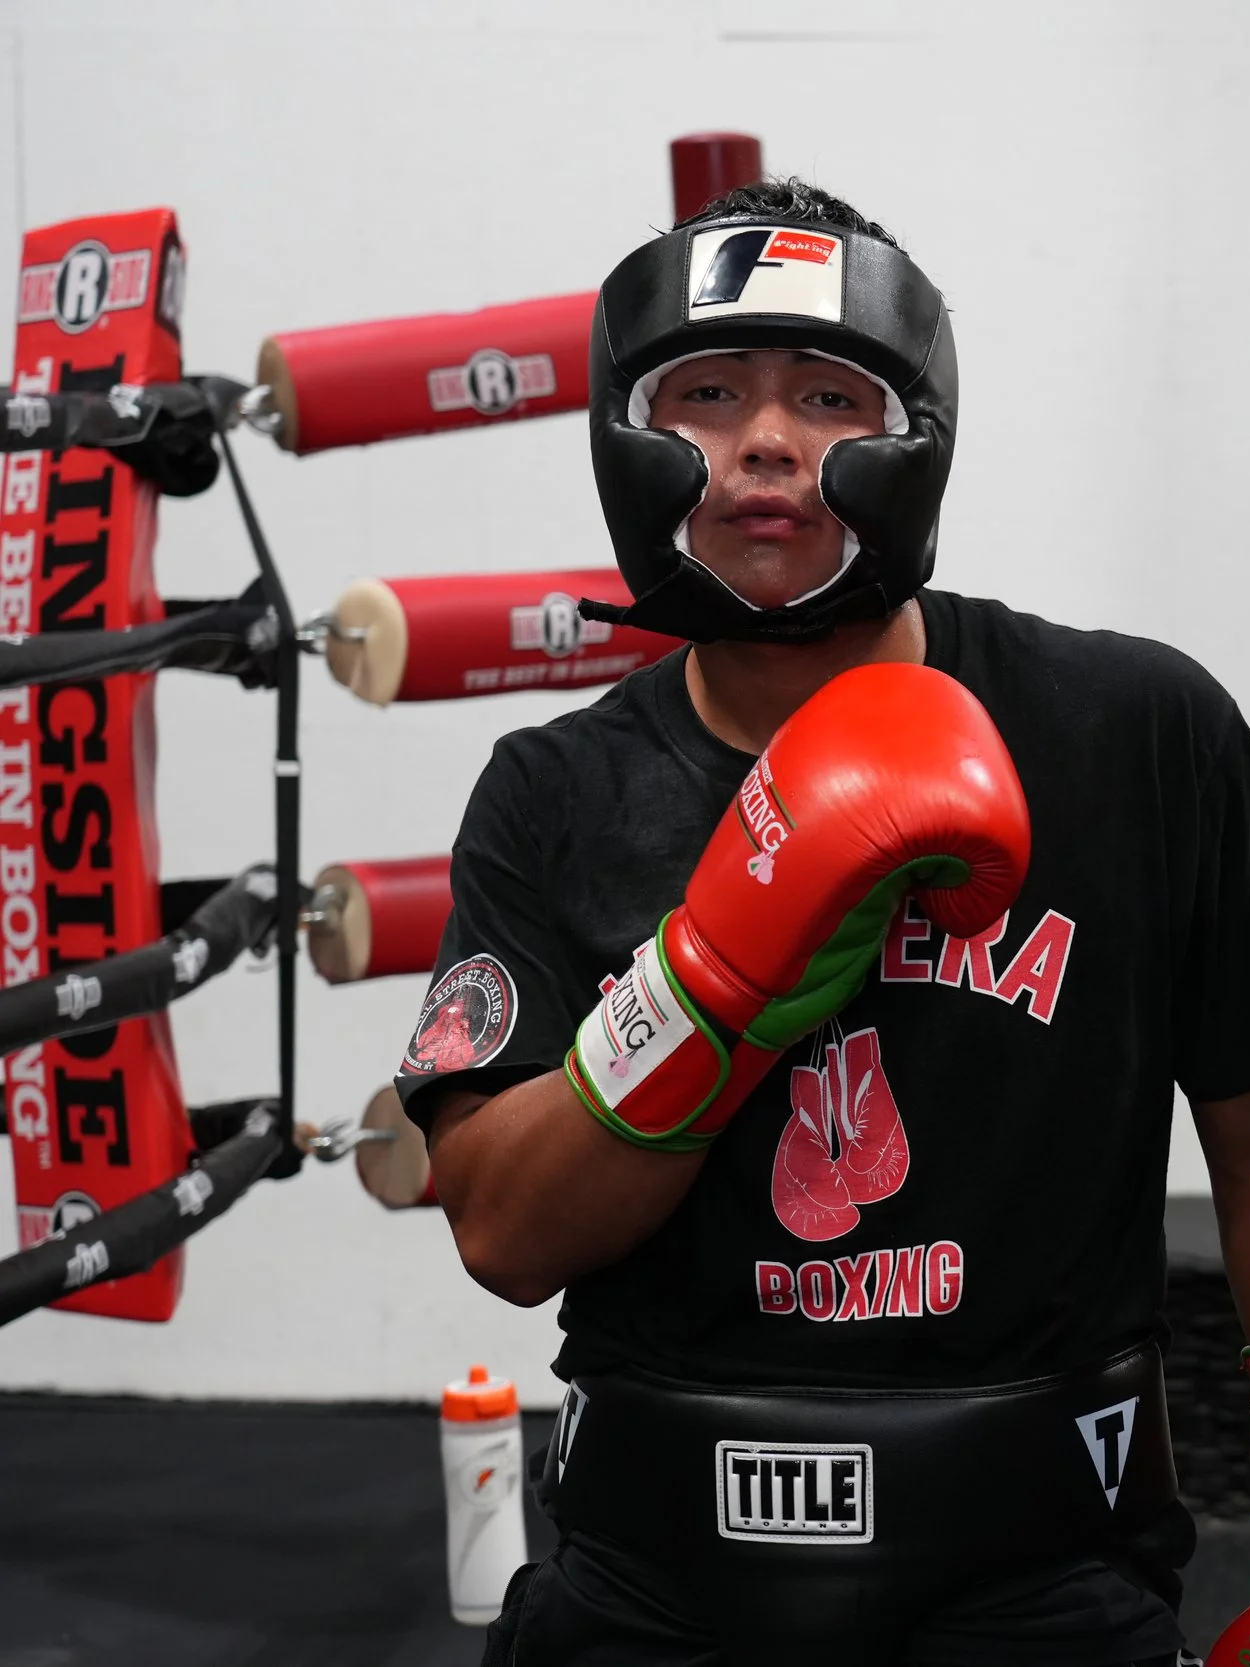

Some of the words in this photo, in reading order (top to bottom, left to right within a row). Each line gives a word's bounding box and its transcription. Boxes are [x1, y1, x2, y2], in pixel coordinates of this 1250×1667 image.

[0, 740, 34, 829] IN
[741, 762, 788, 852] OXING
[755, 1240, 964, 1322] BOXING
[731, 1456, 857, 1522] TITLE
[743, 1519, 849, 1530] BOXING
